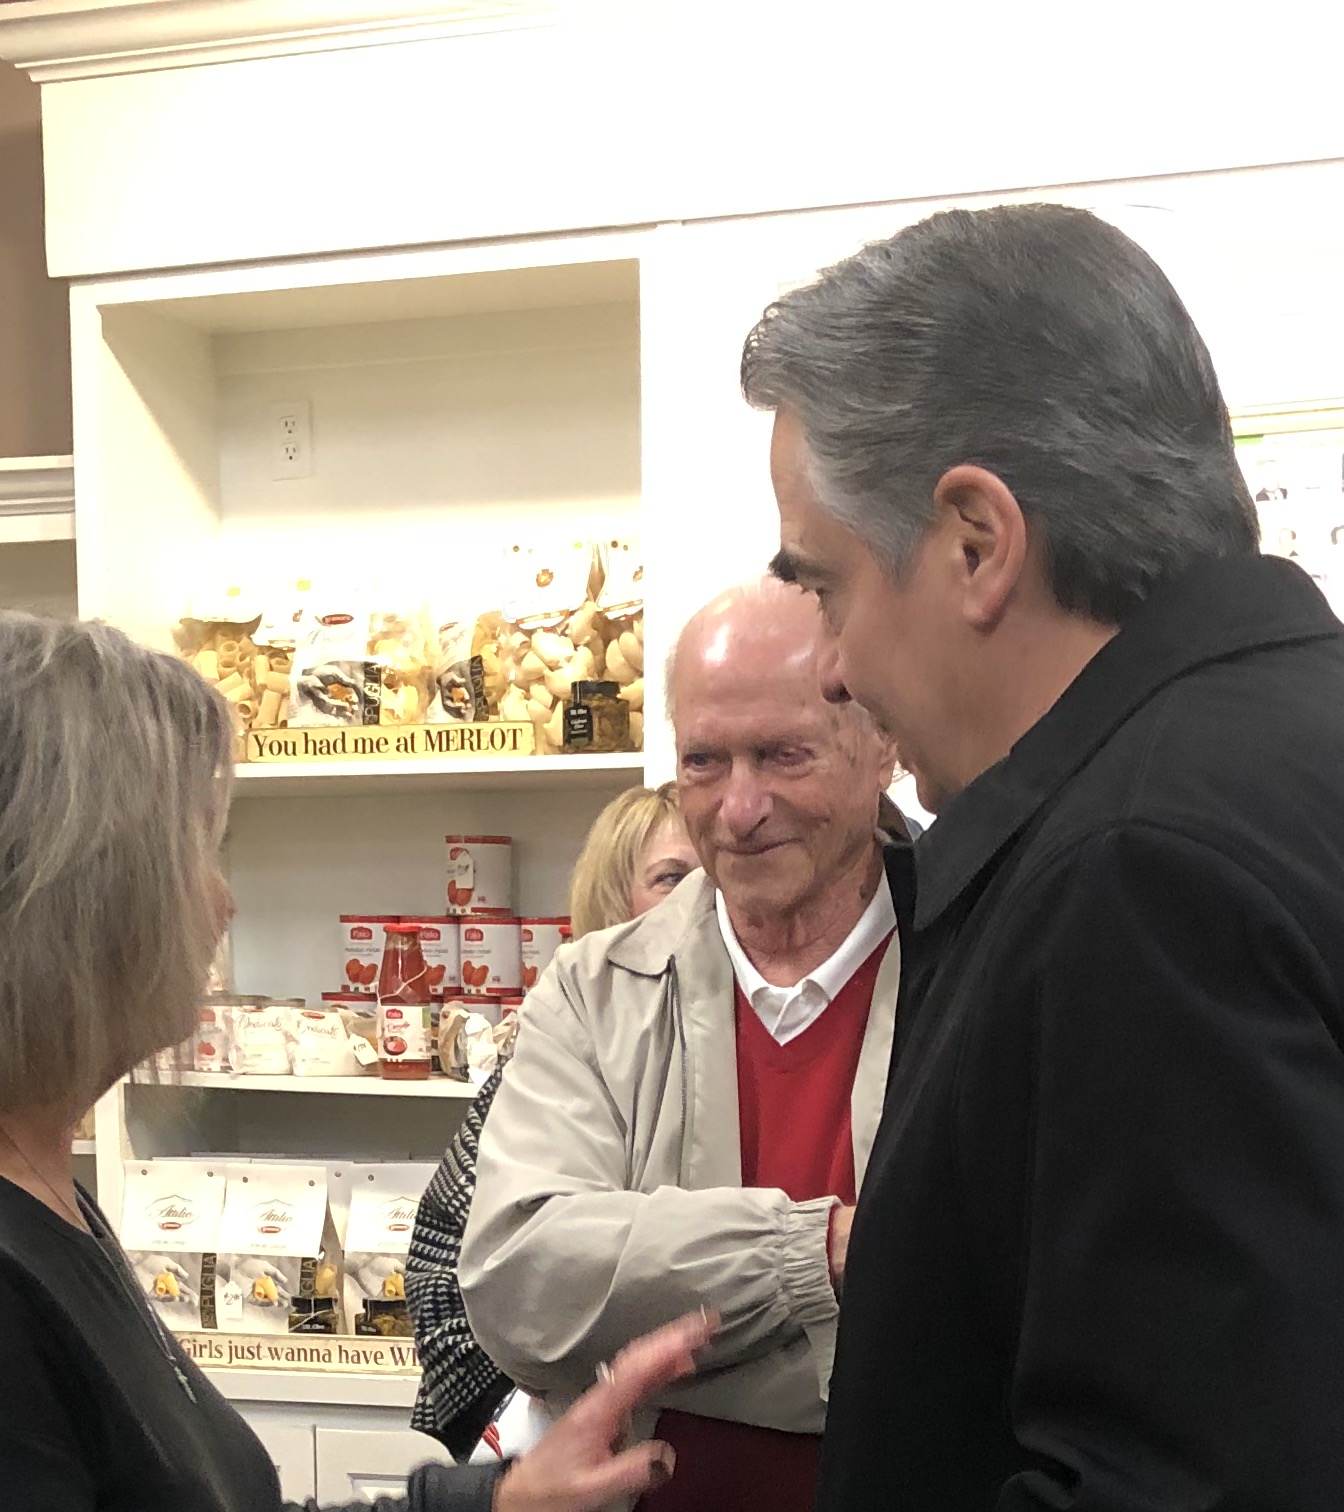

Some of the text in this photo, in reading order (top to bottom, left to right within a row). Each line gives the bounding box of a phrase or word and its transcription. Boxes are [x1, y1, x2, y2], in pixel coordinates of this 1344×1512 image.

[253, 727, 524, 758] You had me at MERLOT
[179, 1338, 224, 1359] Girls
[228, 1340, 263, 1365] just
[267, 1346, 333, 1364] wanna
[338, 1344, 385, 1366] have
